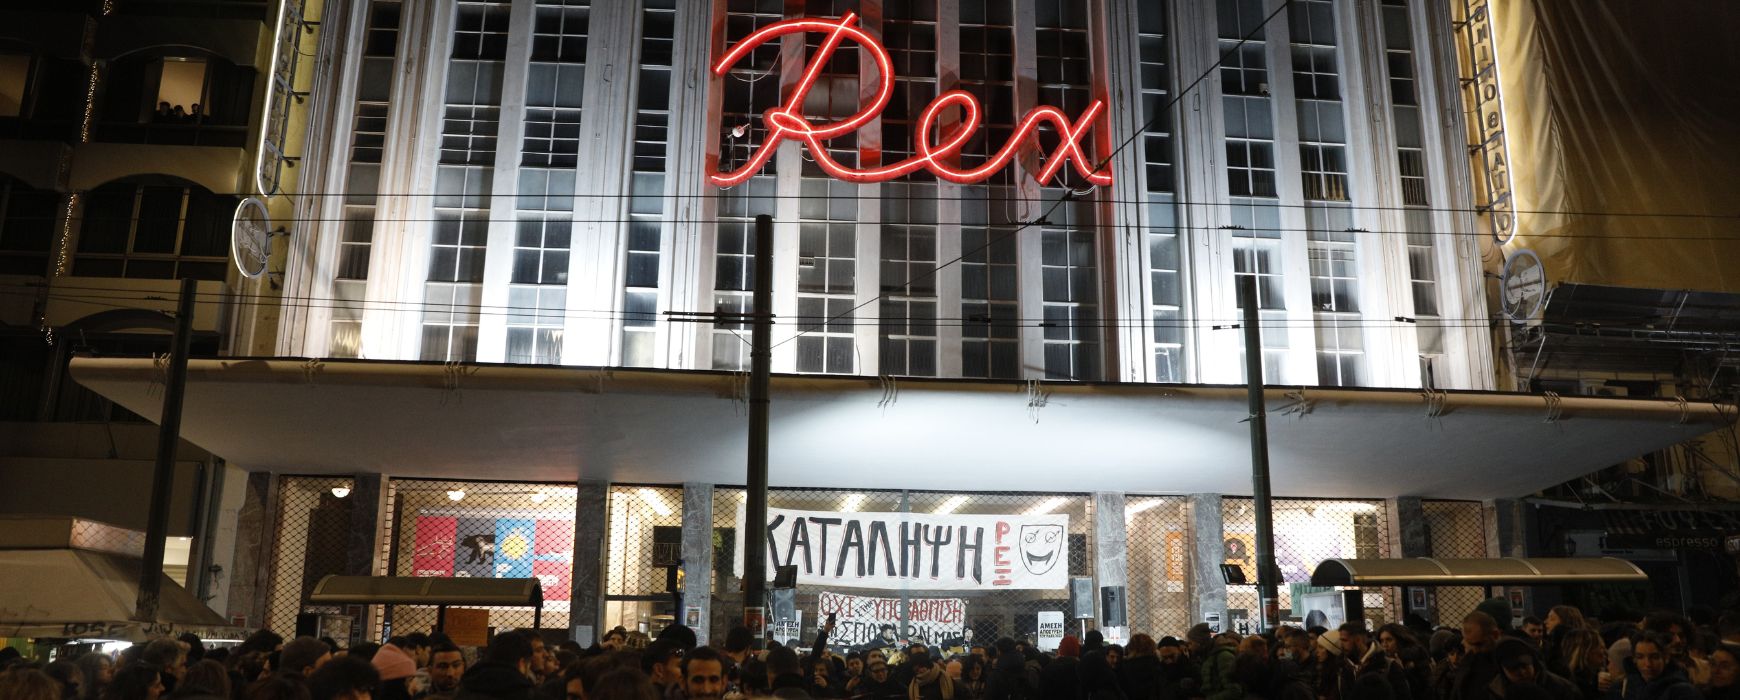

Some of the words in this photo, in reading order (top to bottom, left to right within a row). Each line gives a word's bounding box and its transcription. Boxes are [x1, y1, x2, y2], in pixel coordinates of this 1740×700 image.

[710, 9, 1113, 187] Rex
[766, 514, 984, 585] ΚΑΤΑΛΗΨΗ
[1655, 536, 1719, 549] espresso
[820, 593, 855, 618] ΟΧΙ
